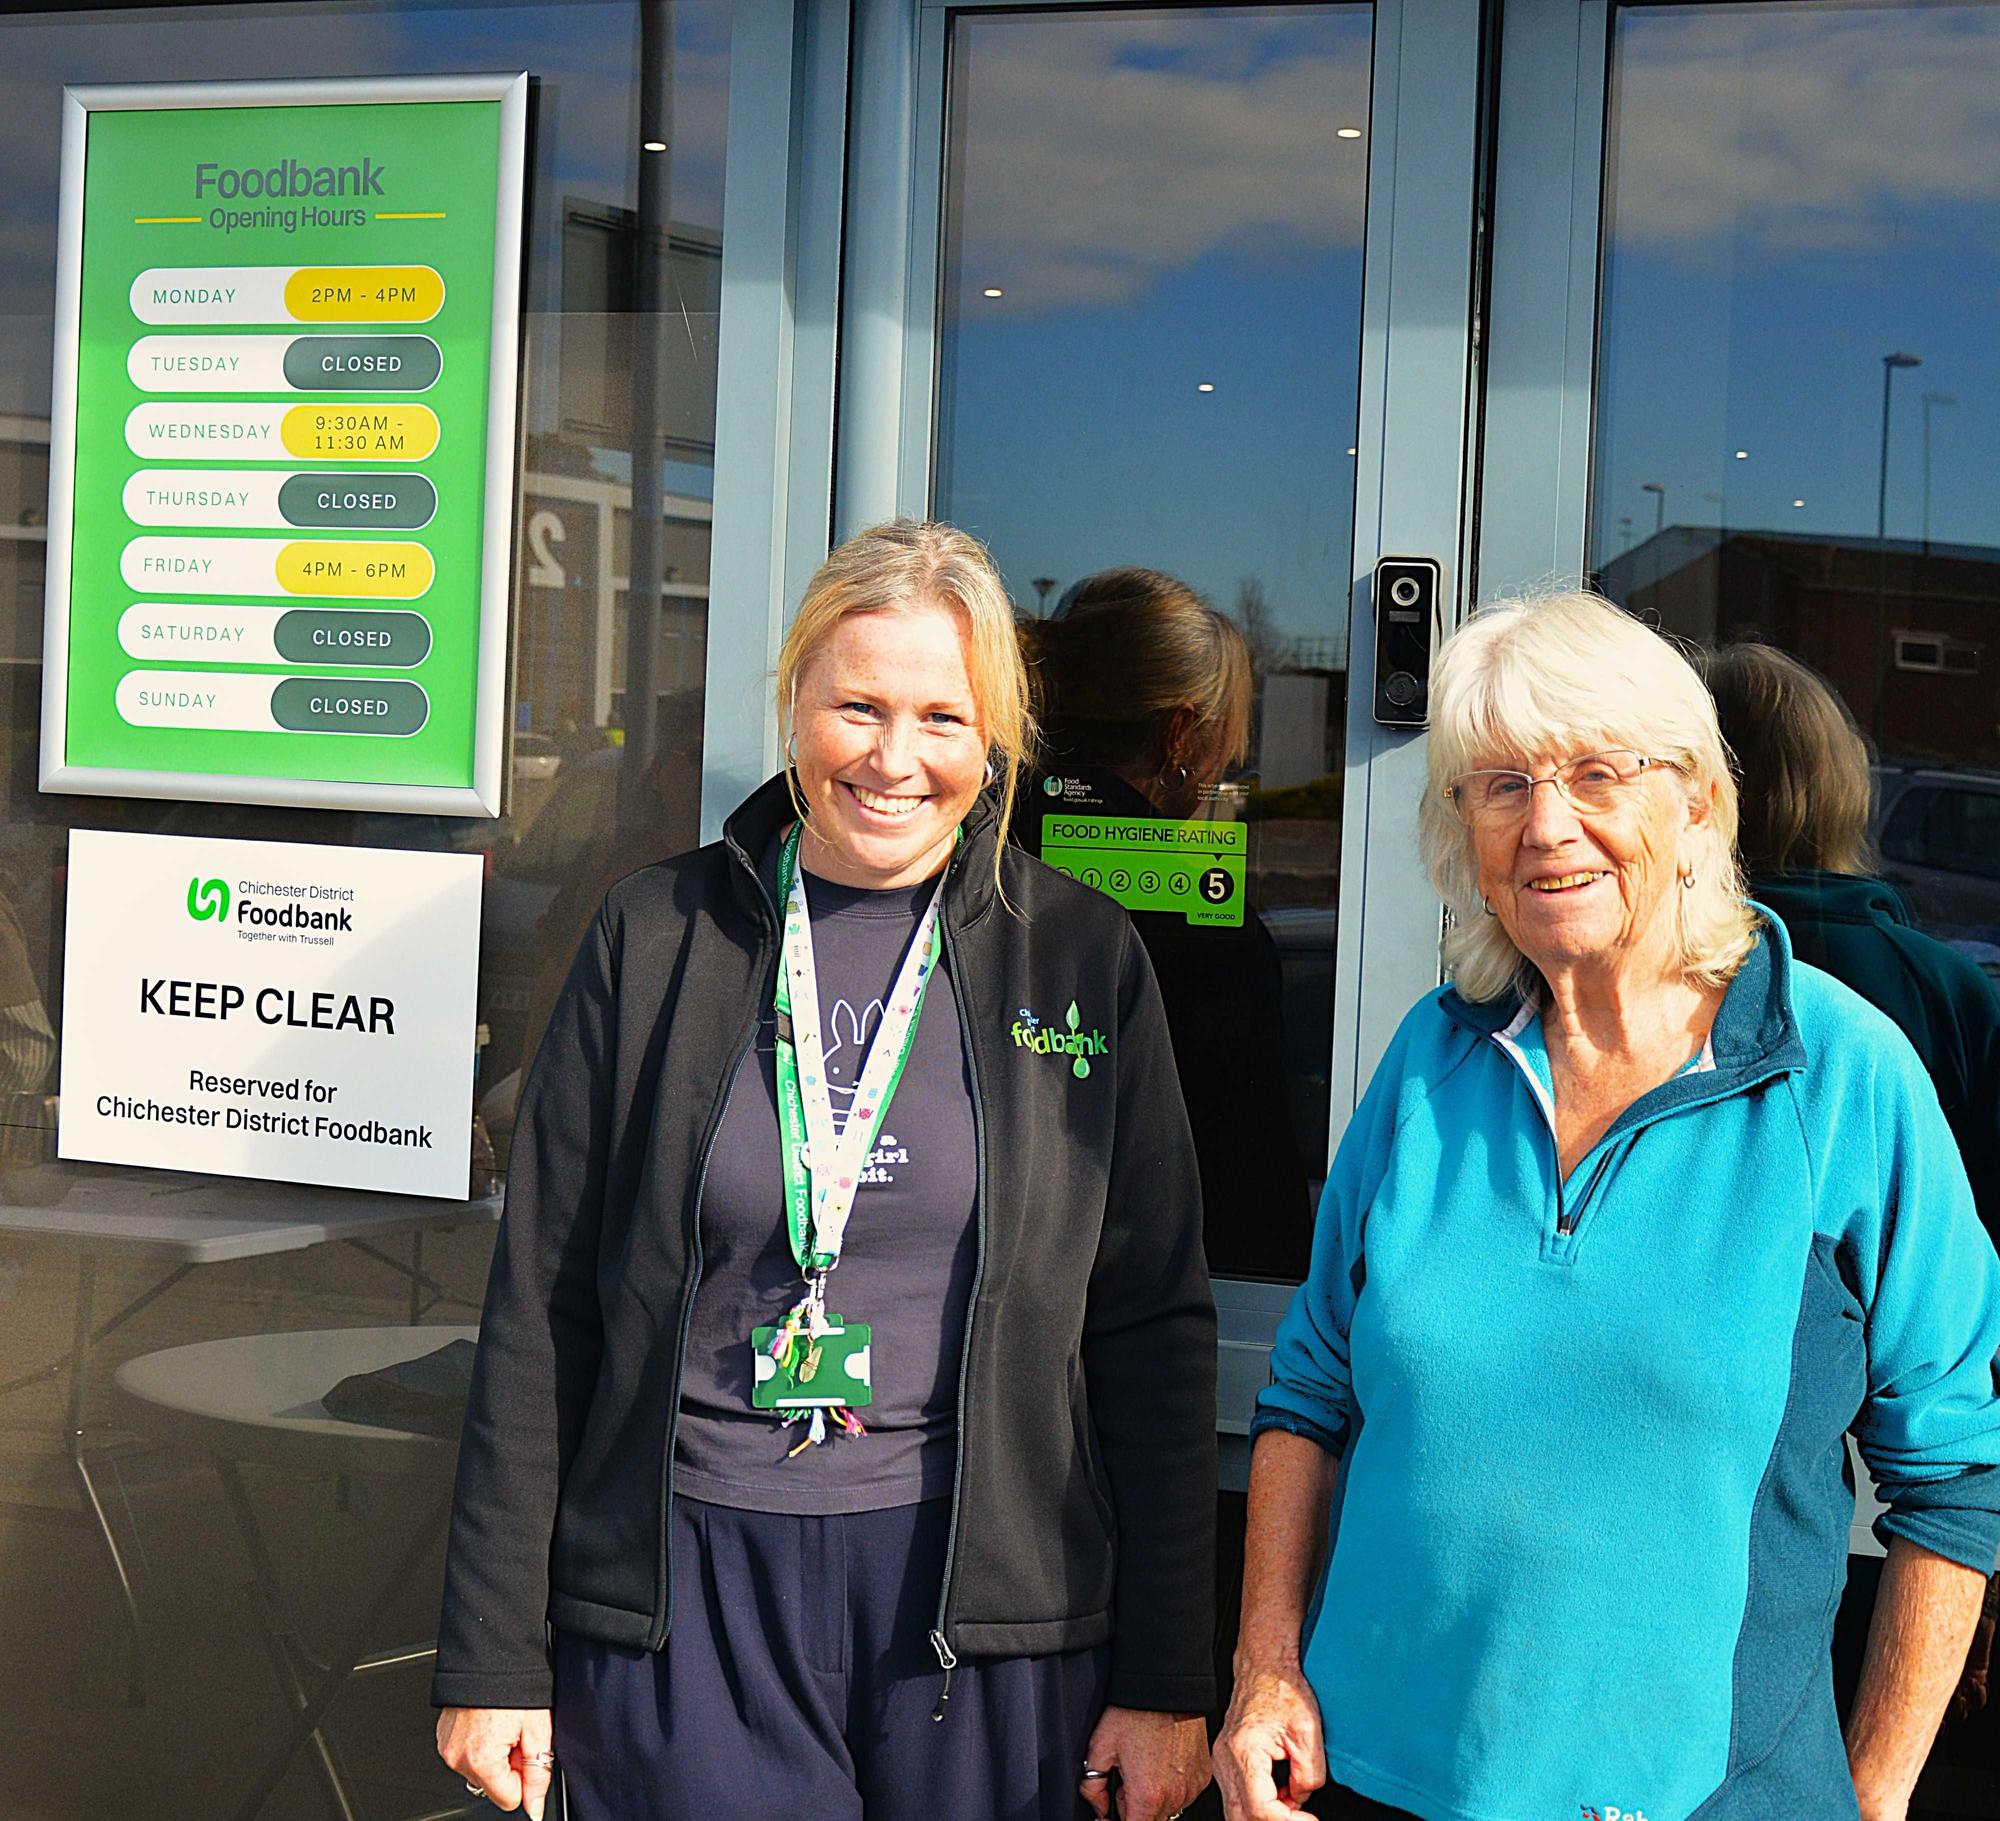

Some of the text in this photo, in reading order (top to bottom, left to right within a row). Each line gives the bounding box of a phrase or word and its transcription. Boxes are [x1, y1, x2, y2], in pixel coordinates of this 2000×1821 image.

[195, 158, 385, 199] Foodbank
[209, 206, 367, 233] Opening Hours
[152, 288, 236, 304] MONDAY
[311, 287, 353, 303] 2PM
[375, 286, 417, 303] 4PM
[151, 356, 402, 373] TUESDAY CLOSED
[148, 423, 271, 440] WEDNESDAY
[315, 415, 389, 431] 9:30AM
[314, 435, 405, 451] 11:30 AM
[146, 490, 398, 510] THURSDAY CLOSED
[143, 557, 213, 574] FRIDAY
[302, 562, 343, 578] 4PM
[365, 562, 406, 578] 6PM
[141, 624, 392, 648] SATURDAY CLOSED
[138, 691, 389, 716] SUNDAY CLOSED
[1064, 777, 1080, 785] Food
[1063, 789, 1086, 797] Agency
[1052, 823, 1236, 845] FOOD HYGIENE RATING
[238, 880, 355, 901] Chichester District
[1088, 873, 1226, 900] 1 2 3 4 5
[238, 900, 352, 931] Foodbank
[237, 930, 334, 946] Together with Trussell
[140, 978, 396, 1035] KEEP CLEAR
[189, 1070, 338, 1104] Reserved for
[96, 1095, 433, 1149] Chichester District Foodbank
[785, 1080, 801, 1140] Chichester
[795, 1188, 808, 1250] Foodbank
